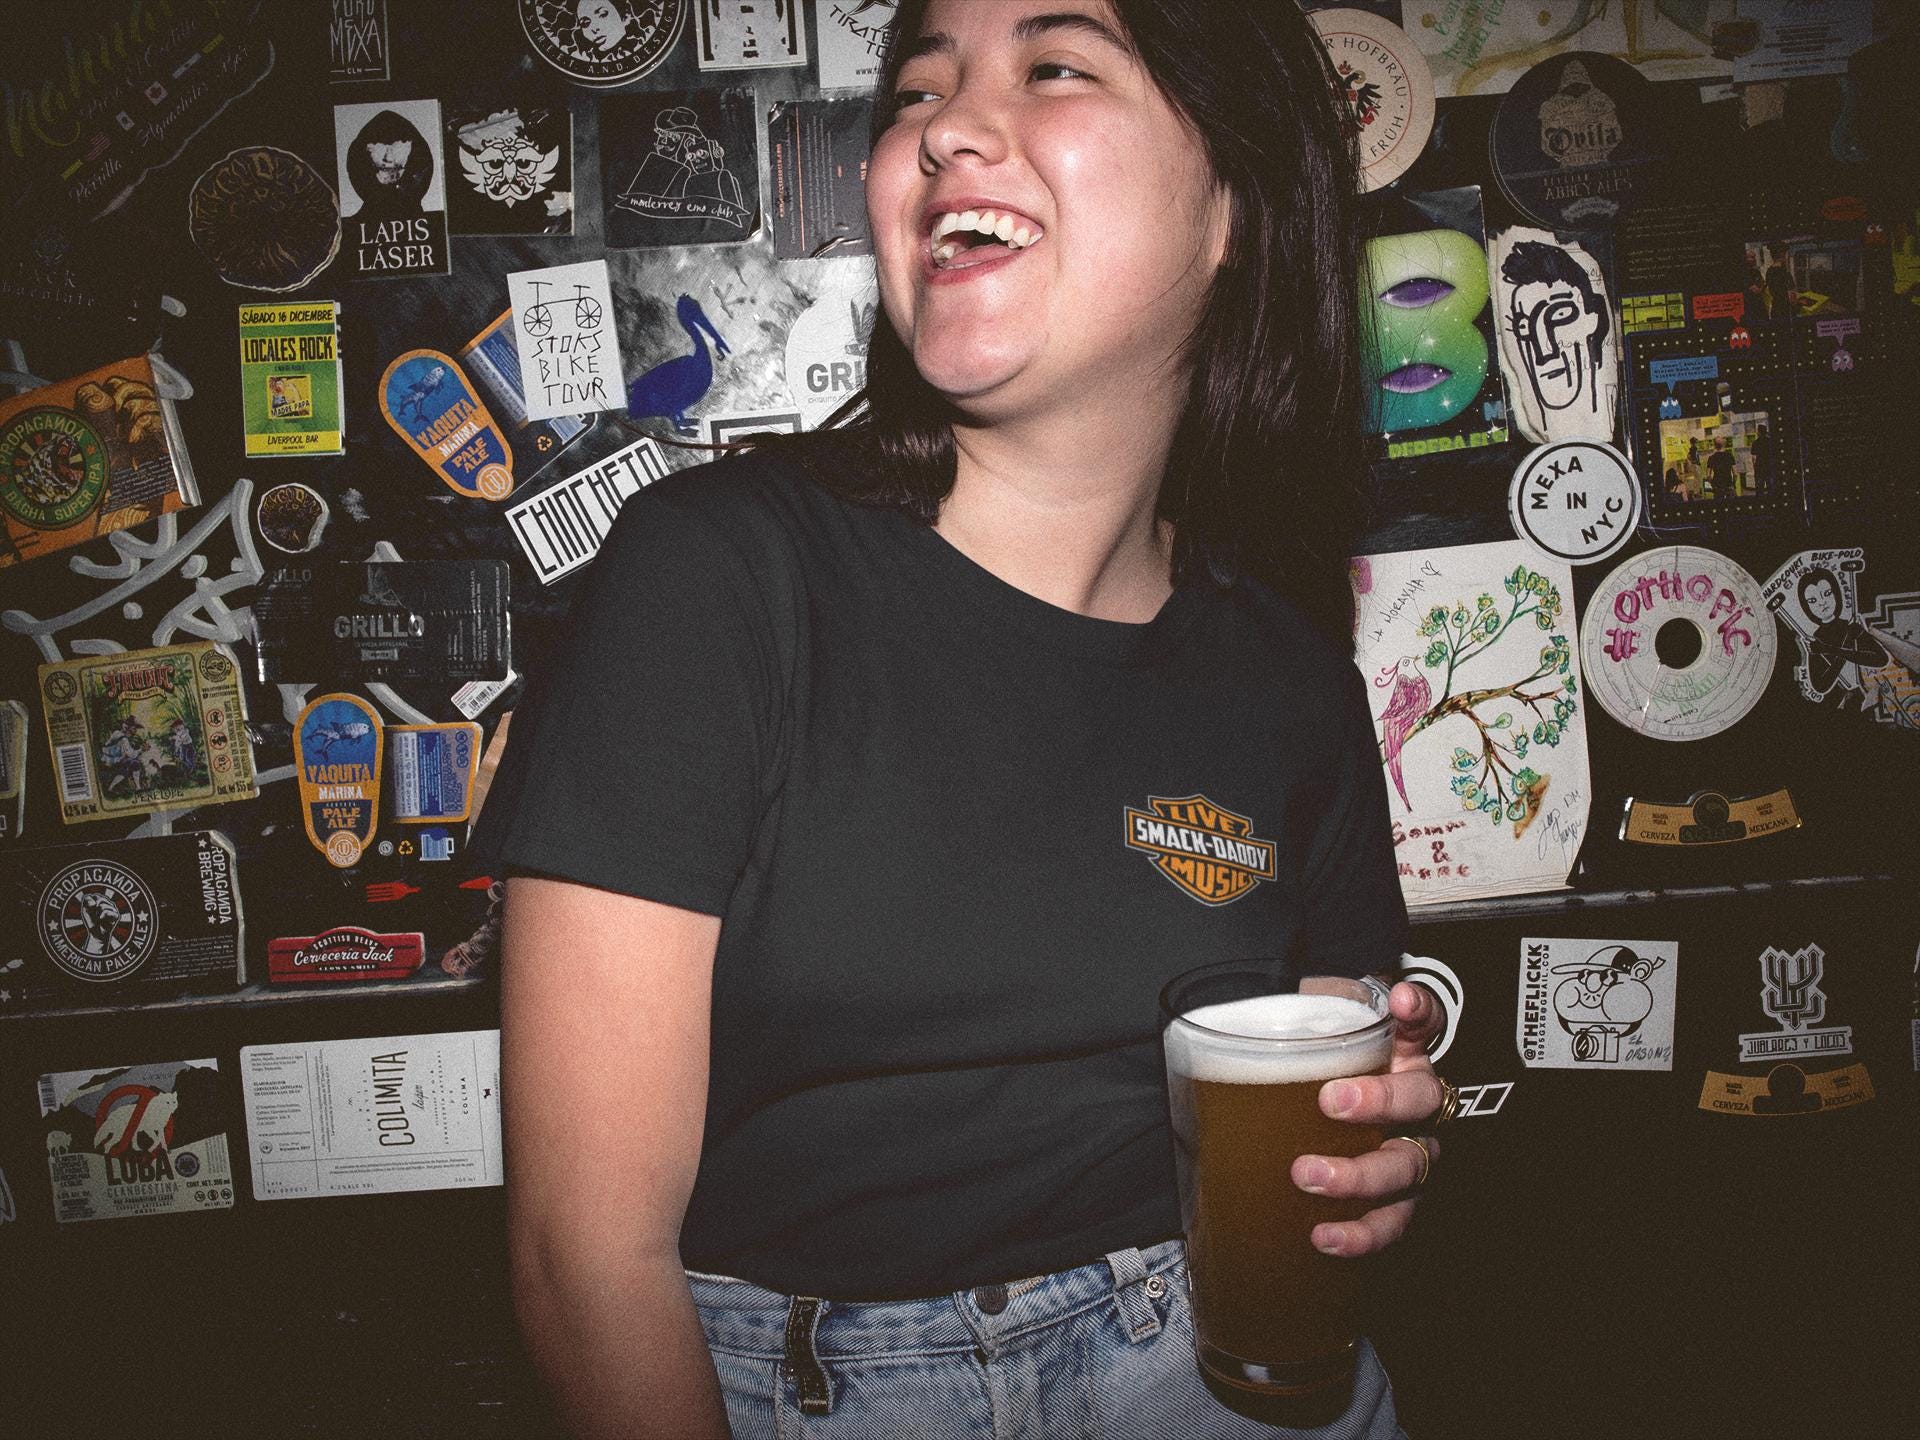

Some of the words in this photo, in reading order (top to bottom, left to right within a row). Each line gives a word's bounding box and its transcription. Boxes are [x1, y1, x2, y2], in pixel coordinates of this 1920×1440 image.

[1370, 115, 1404, 157] FRÜH
[686, 202, 707, 212] emo
[359, 217, 430, 246] LAPIS
[289, 309, 333, 322] DICIEMBRE
[244, 336, 296, 364] LOCALES
[299, 334, 333, 361] ROCK
[539, 354, 601, 383] BIKE
[267, 435, 303, 445] LIVERPOOL
[306, 435, 319, 443] BAR
[451, 437, 488, 469] PALE
[462, 449, 490, 474] ALE
[55, 489, 94, 521] SUPER
[89, 462, 101, 485] IPA
[1530, 455, 1584, 511] MEXA
[1566, 492, 1588, 510] IN
[1580, 496, 1624, 546] NYC
[333, 614, 425, 638] GRILLO
[319, 785, 363, 800] MARINA
[322, 807, 361, 818] PALE
[327, 818, 357, 829] ALE
[1169, 803, 1237, 835] LIVE
[1136, 817, 1268, 871] SMACK-DADDY
[1640, 830, 1676, 841] CERVEZA
[1749, 817, 1790, 834] MEXICANA
[50, 867, 141, 910] PROPAGANDA
[198, 851, 217, 913] BREWING
[210, 846, 233, 924] ROPAGANDA
[1170, 856, 1248, 898] MUSIC
[51, 933, 102, 973] AMERICAN
[105, 951, 136, 973] PALE
[131, 923, 149, 950] ALE
[362, 946, 395, 962] Jack
[1523, 943, 1543, 1061] @THEFLICKK
[371, 1050, 416, 1147] COLIMITA
[460, 1075, 469, 1116] COLIMA
[1712, 1100, 1750, 1112] CERVEZA
